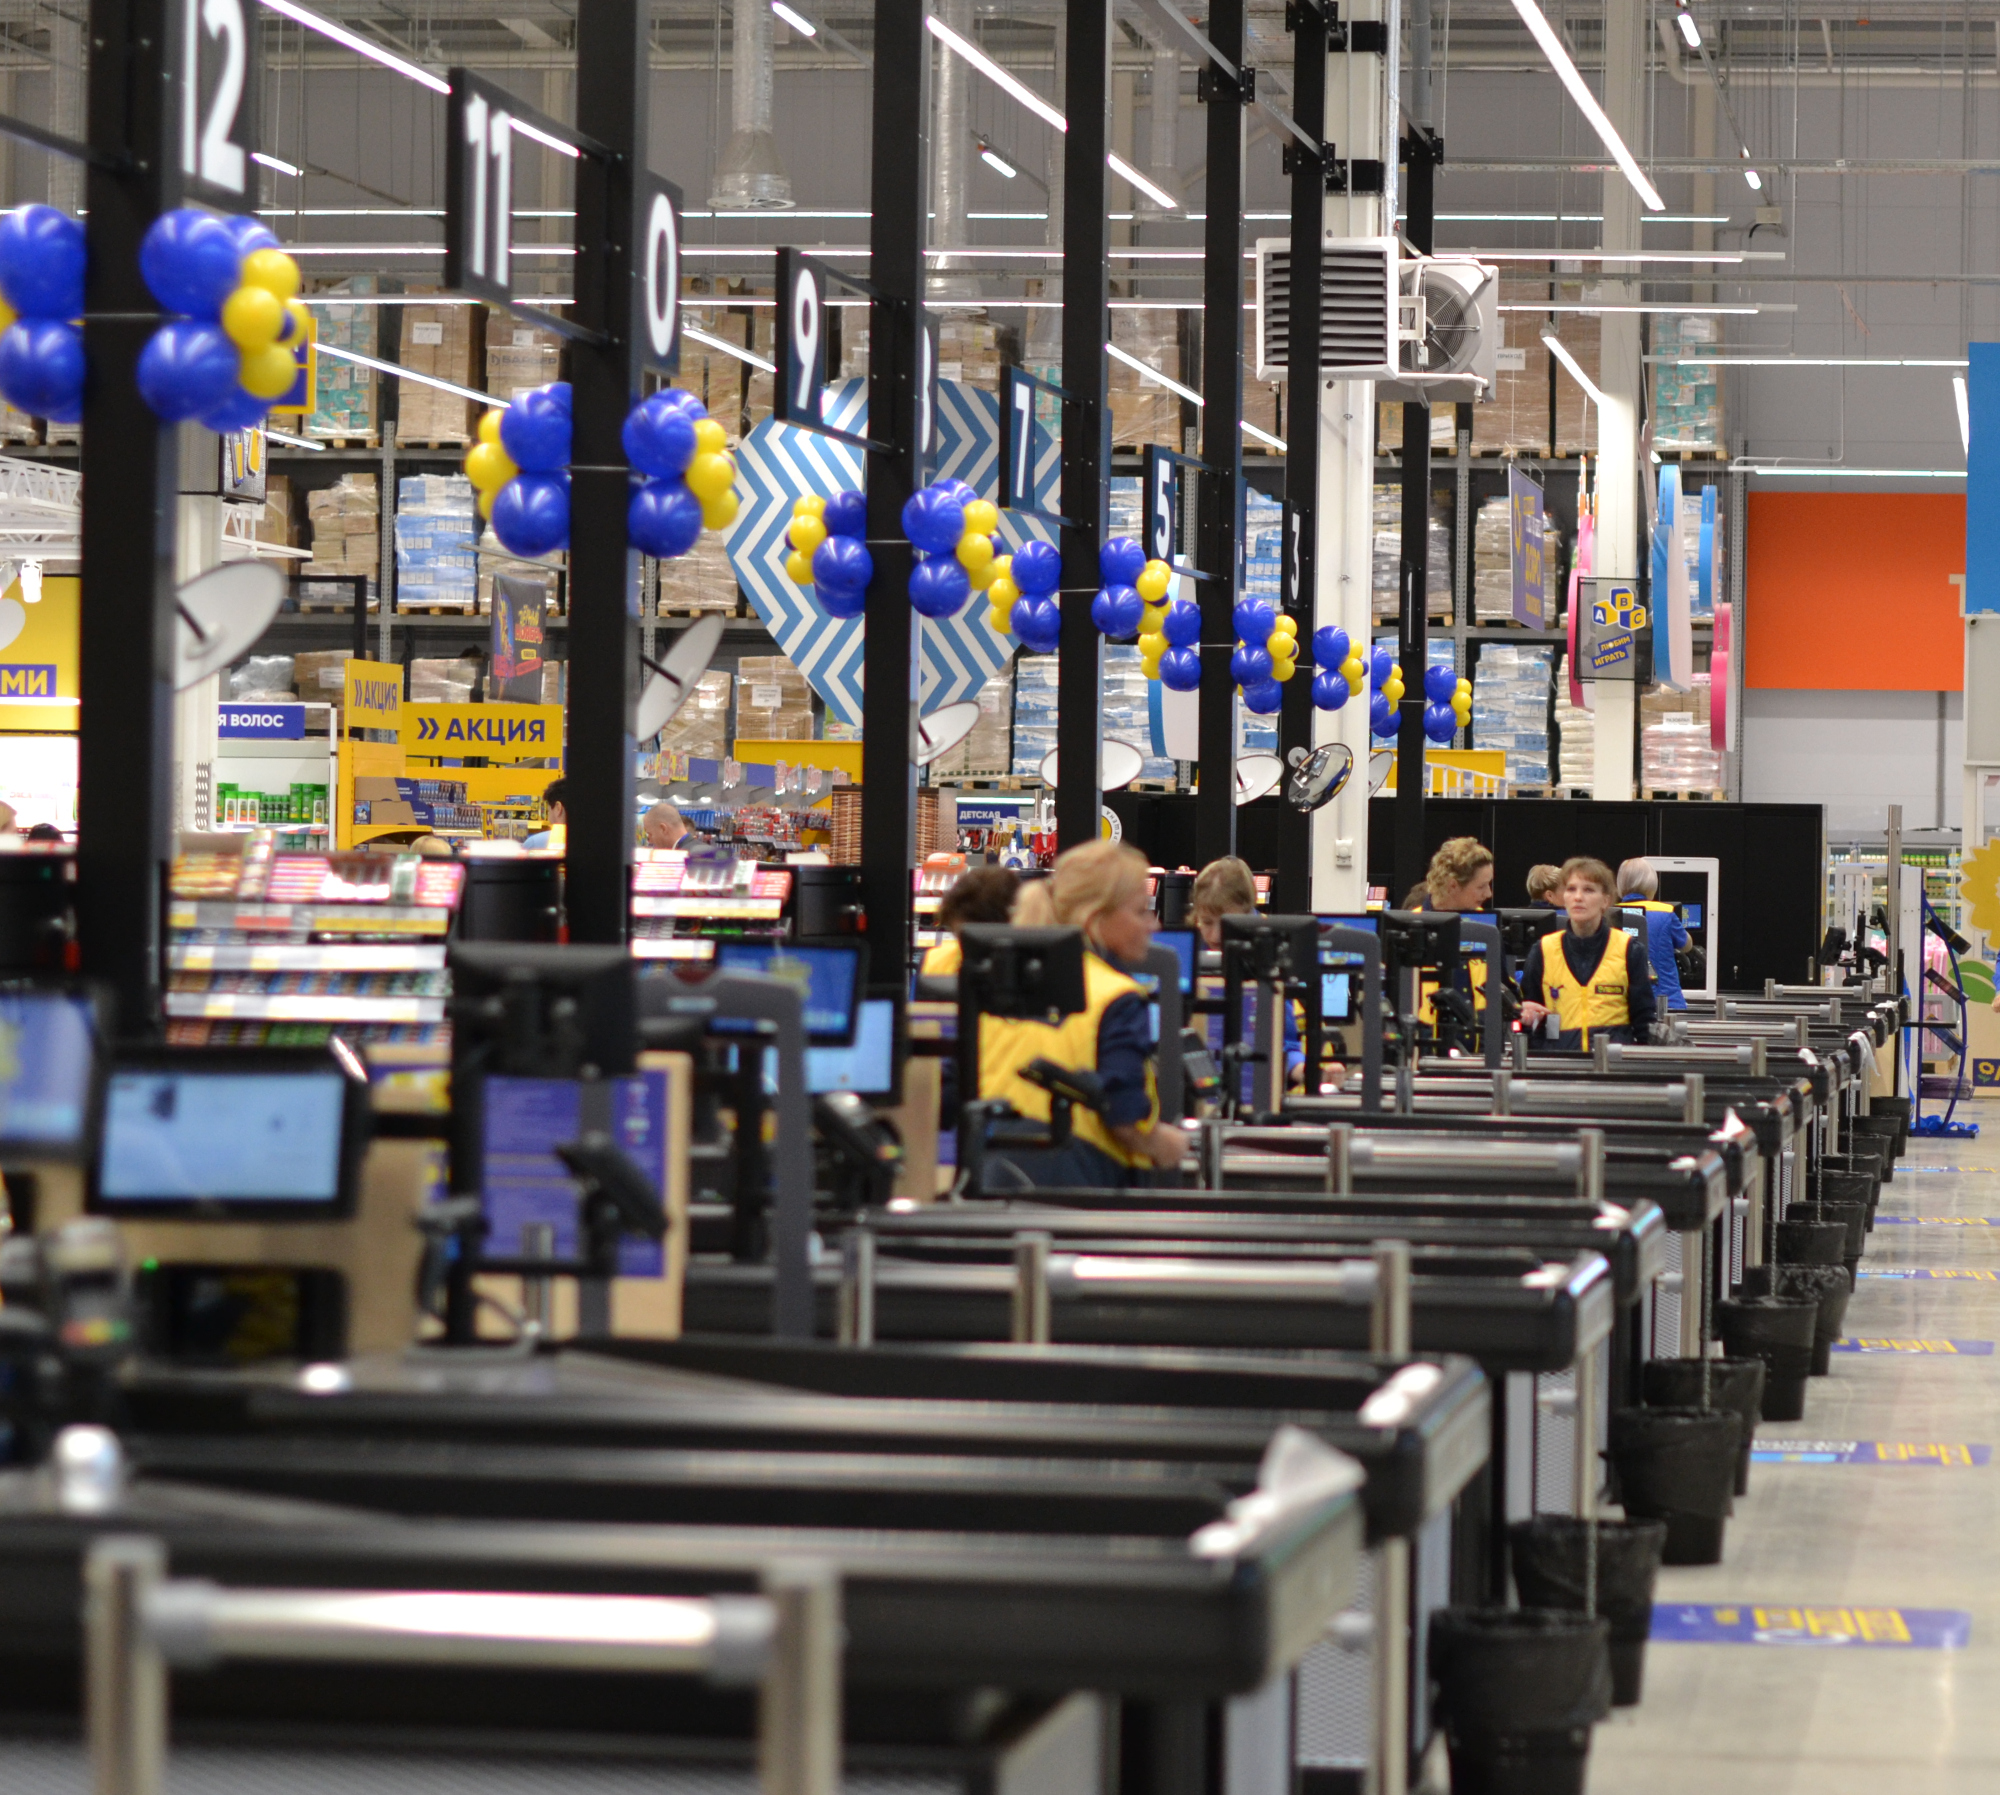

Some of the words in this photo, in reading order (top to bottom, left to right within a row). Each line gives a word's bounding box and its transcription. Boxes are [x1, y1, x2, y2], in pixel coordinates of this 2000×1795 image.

[466, 93, 511, 286] 11
[646, 192, 678, 357] 0
[794, 267, 819, 410] 9
[1015, 382, 1030, 498] 7
[1156, 458, 1170, 559] 5
[1291, 512, 1300, 600] 3
[1595, 609, 1605, 622] A
[1620, 597, 1629, 606] B
[1634, 612, 1643, 624] C
[1594, 650, 1626, 667] ИГРАТЬ
[1600, 635, 1631, 652] ЛЮБИМ
[363, 680, 398, 715] АКЦИЯ
[230, 713, 284, 727] ВОЛОС
[444, 718, 546, 746] АКЦИЯ
[960, 810, 1001, 820] ДЕТСКАЯ
